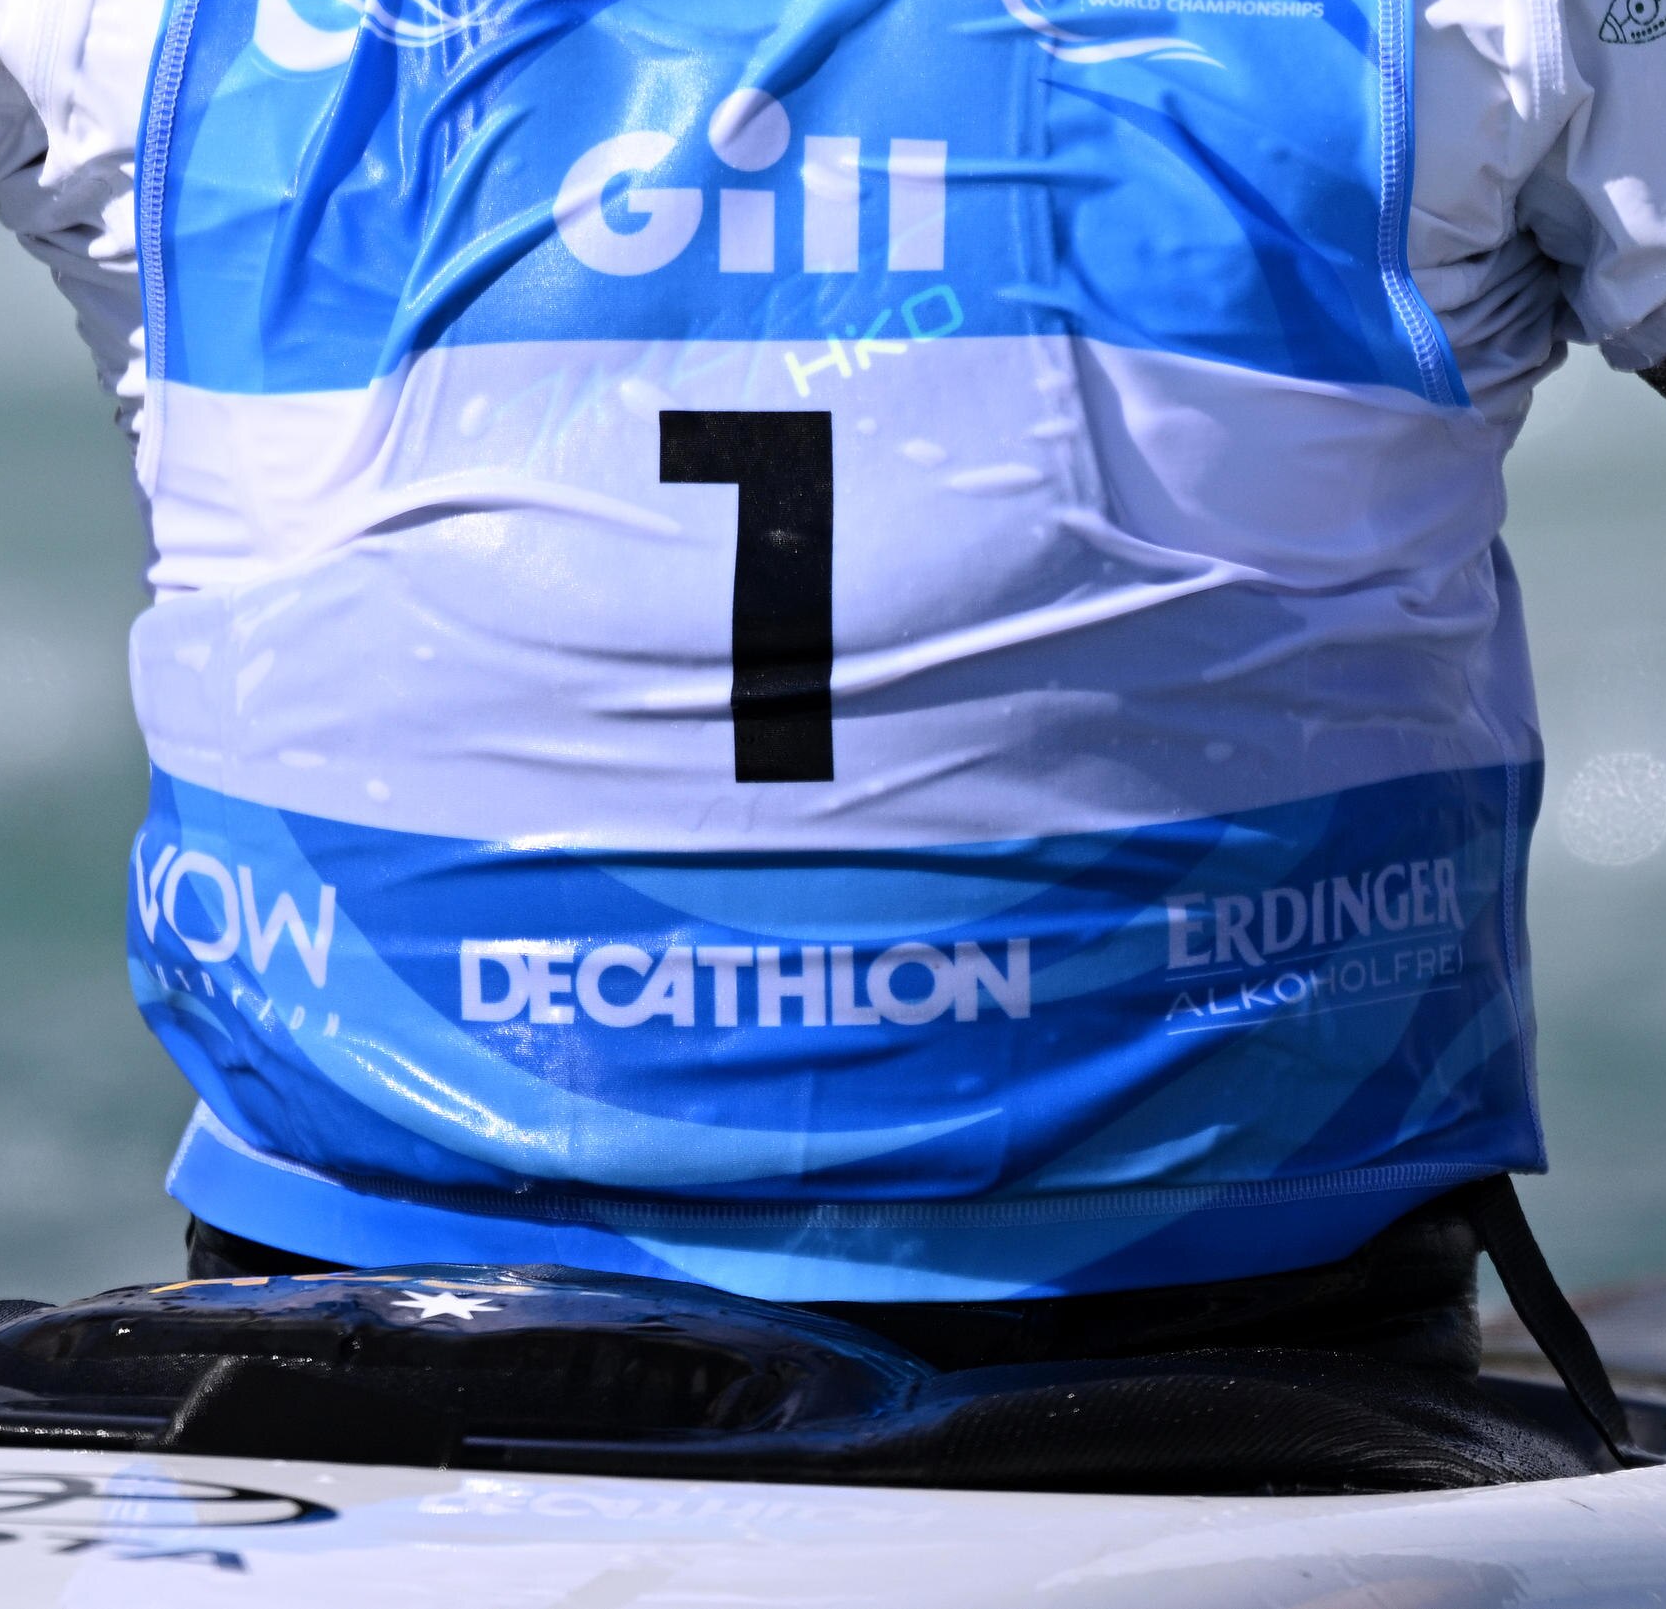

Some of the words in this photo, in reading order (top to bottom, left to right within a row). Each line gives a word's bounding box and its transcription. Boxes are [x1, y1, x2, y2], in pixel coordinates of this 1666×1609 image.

[552, 87, 948, 277] Gill
[659, 409, 834, 783] 1
[1164, 857, 1467, 970] ERDINGER
[459, 937, 1031, 1028] DECATHLON
[1164, 942, 1465, 1022] ALKOHOLFREI
